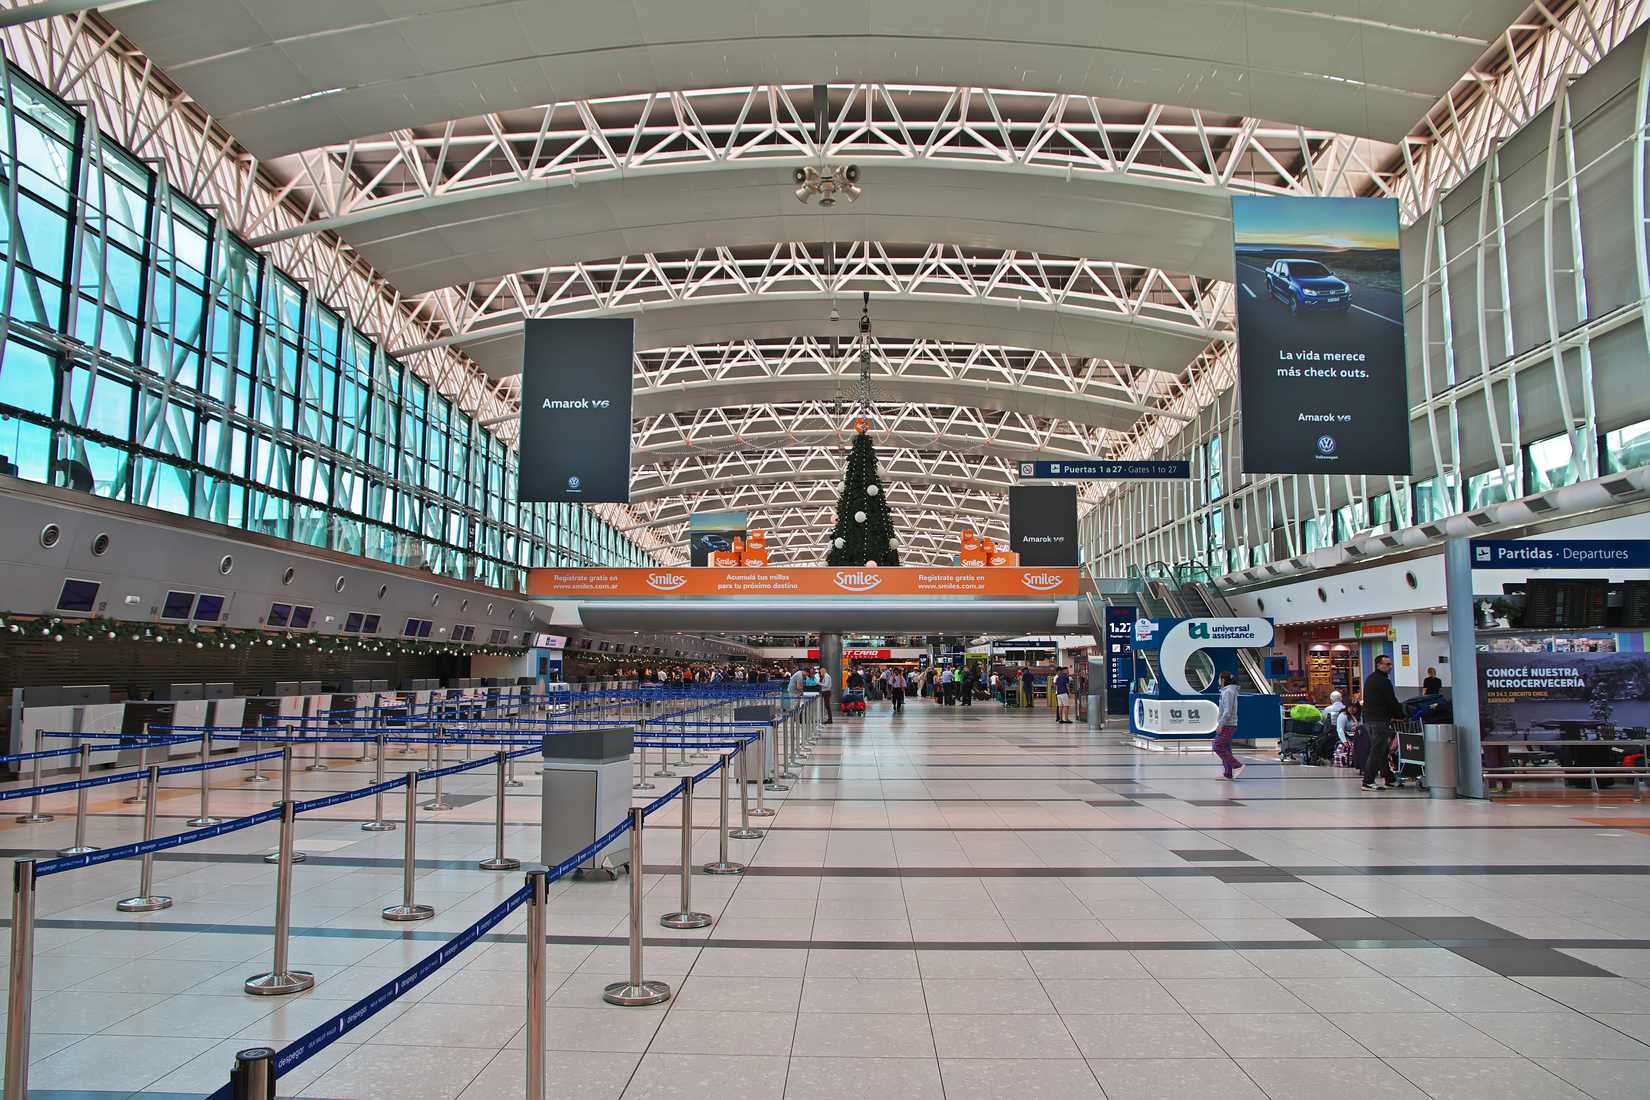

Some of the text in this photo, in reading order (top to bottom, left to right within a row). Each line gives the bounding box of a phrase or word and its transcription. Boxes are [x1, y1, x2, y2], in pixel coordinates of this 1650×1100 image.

[1279, 350, 1366, 361] La vida merece
[1277, 366, 1369, 378] más check outs.
[542, 397, 589, 409] Amarok
[1298, 412, 1335, 422] Amarok
[1064, 465, 1097, 474] Puertas
[1099, 465, 1104, 474] 1
[1112, 465, 1122, 474] 27
[1127, 465, 1150, 474] Gates
[1157, 465, 1166, 474] to
[1167, 465, 1177, 474] 27
[1023, 535, 1052, 543] Amarok
[1498, 547, 1630, 562] Partidas Departures
[648, 572, 686, 588] Smiles
[835, 571, 881, 589] Smiles
[1022, 572, 1063, 588] Smiles
[1212, 624, 1250, 632] universal
[1486, 666, 1580, 678] CONOCÉ NUESTRA
[1486, 677, 1585, 688] MICROCERVECERÍA
[278, 1046, 305, 1068] despegar
